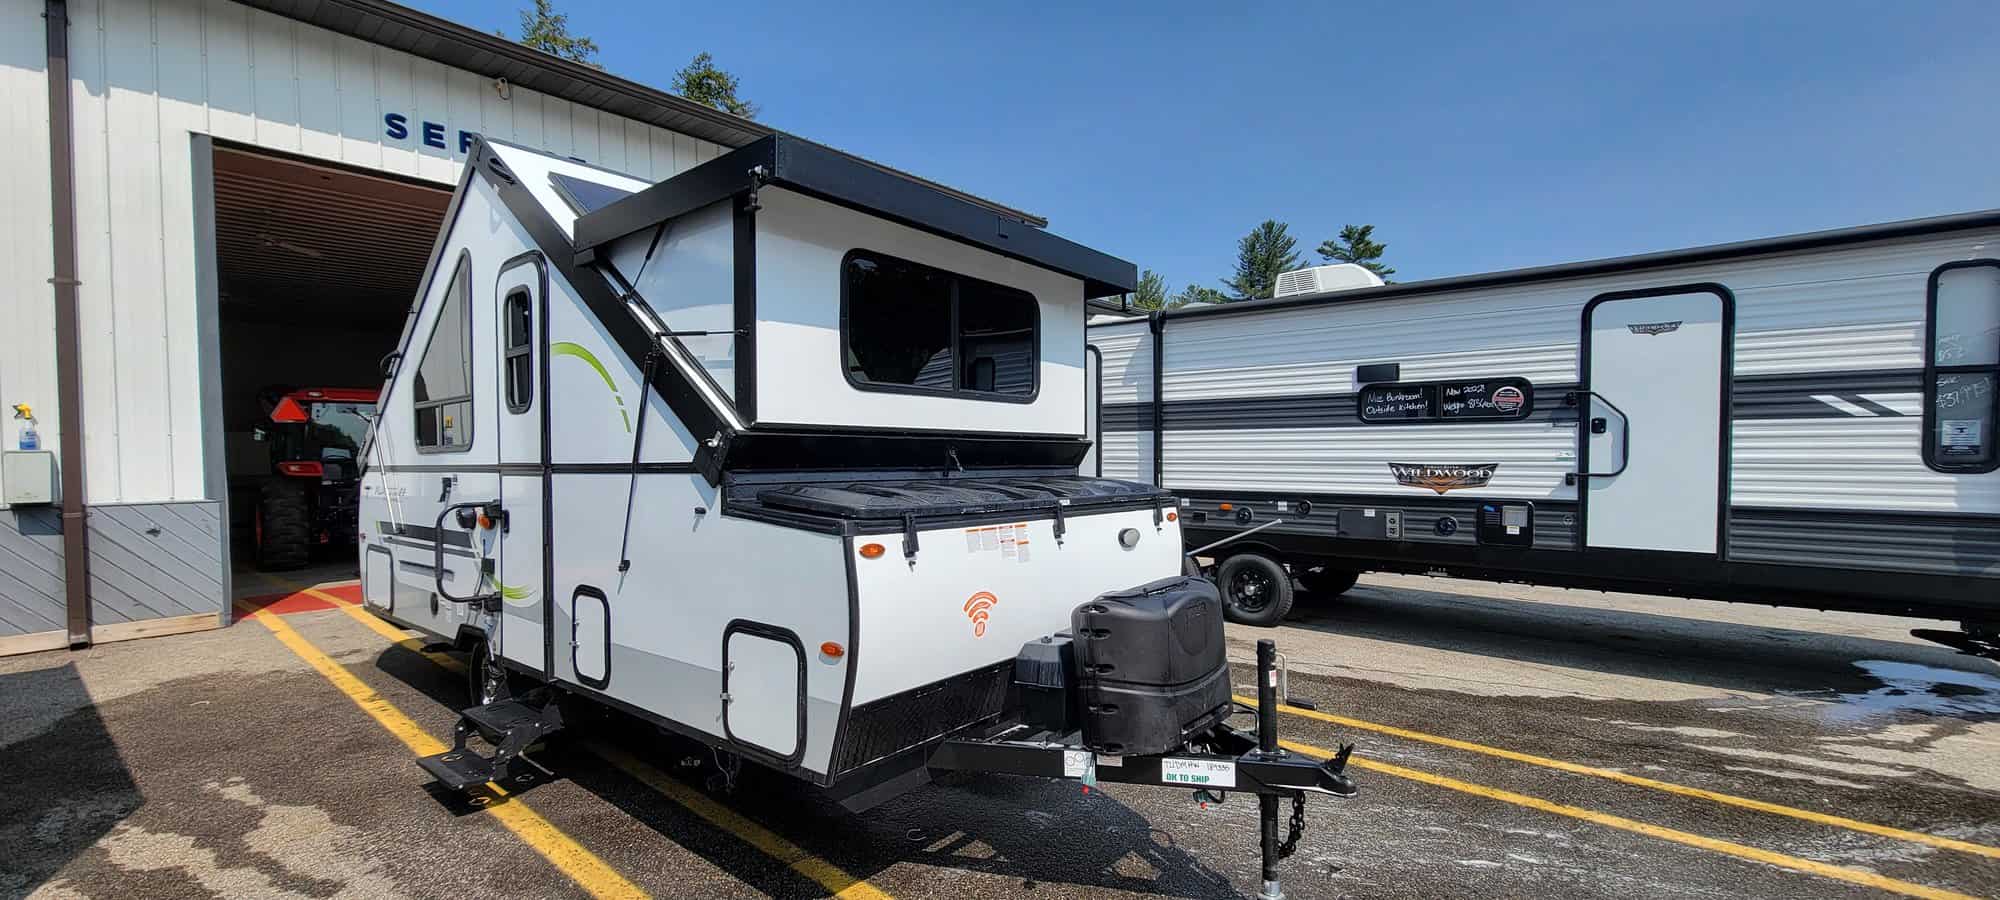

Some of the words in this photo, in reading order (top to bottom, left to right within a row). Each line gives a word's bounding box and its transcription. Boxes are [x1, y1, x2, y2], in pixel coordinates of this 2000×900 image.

[1391, 467, 1492, 478] WILDWOOD
[1166, 773, 1177, 782] OK
[1180, 774, 1189, 782] TO
[1191, 775, 1210, 784] SHIP
